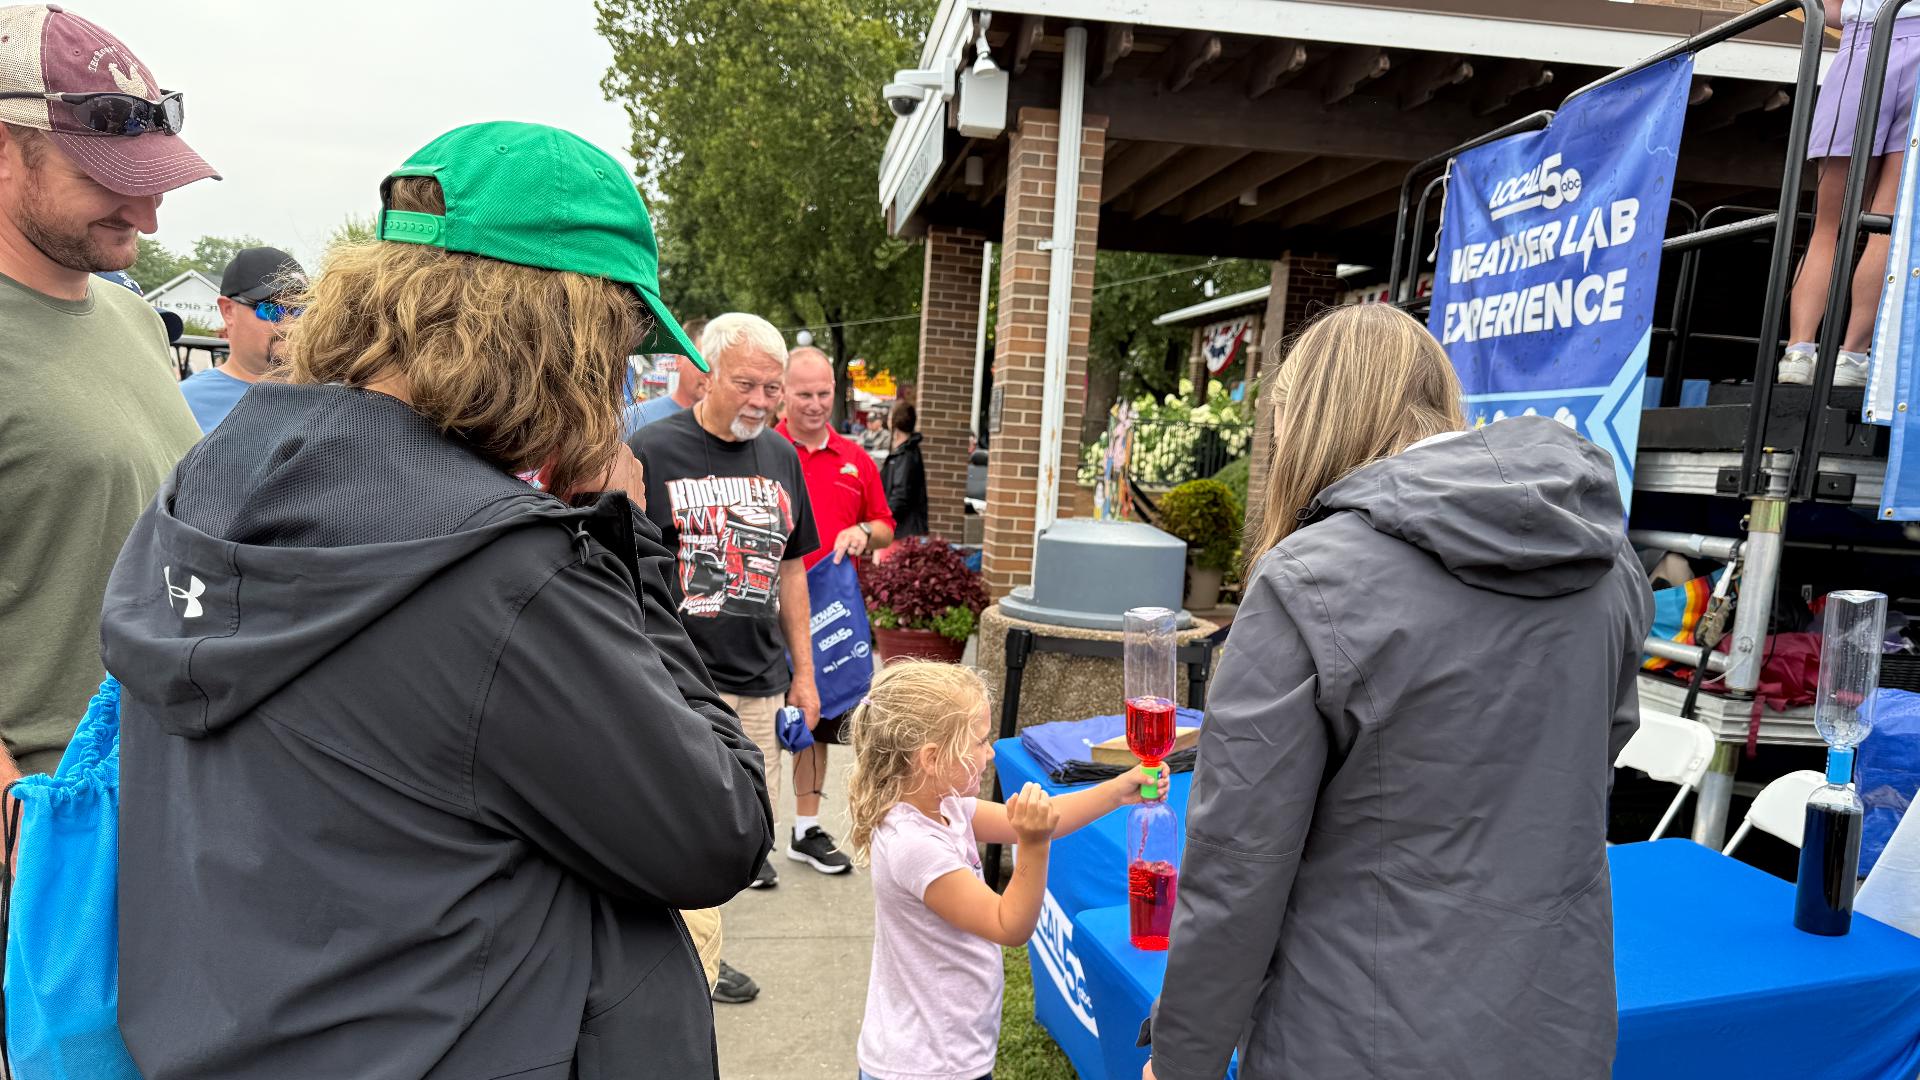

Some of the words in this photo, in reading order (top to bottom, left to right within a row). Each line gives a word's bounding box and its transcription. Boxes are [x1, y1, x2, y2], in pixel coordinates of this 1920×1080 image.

[1450, 220, 1561, 284] WEATHER
[1560, 198, 1639, 272] LAB
[1443, 268, 1628, 345] EXPERIENCE
